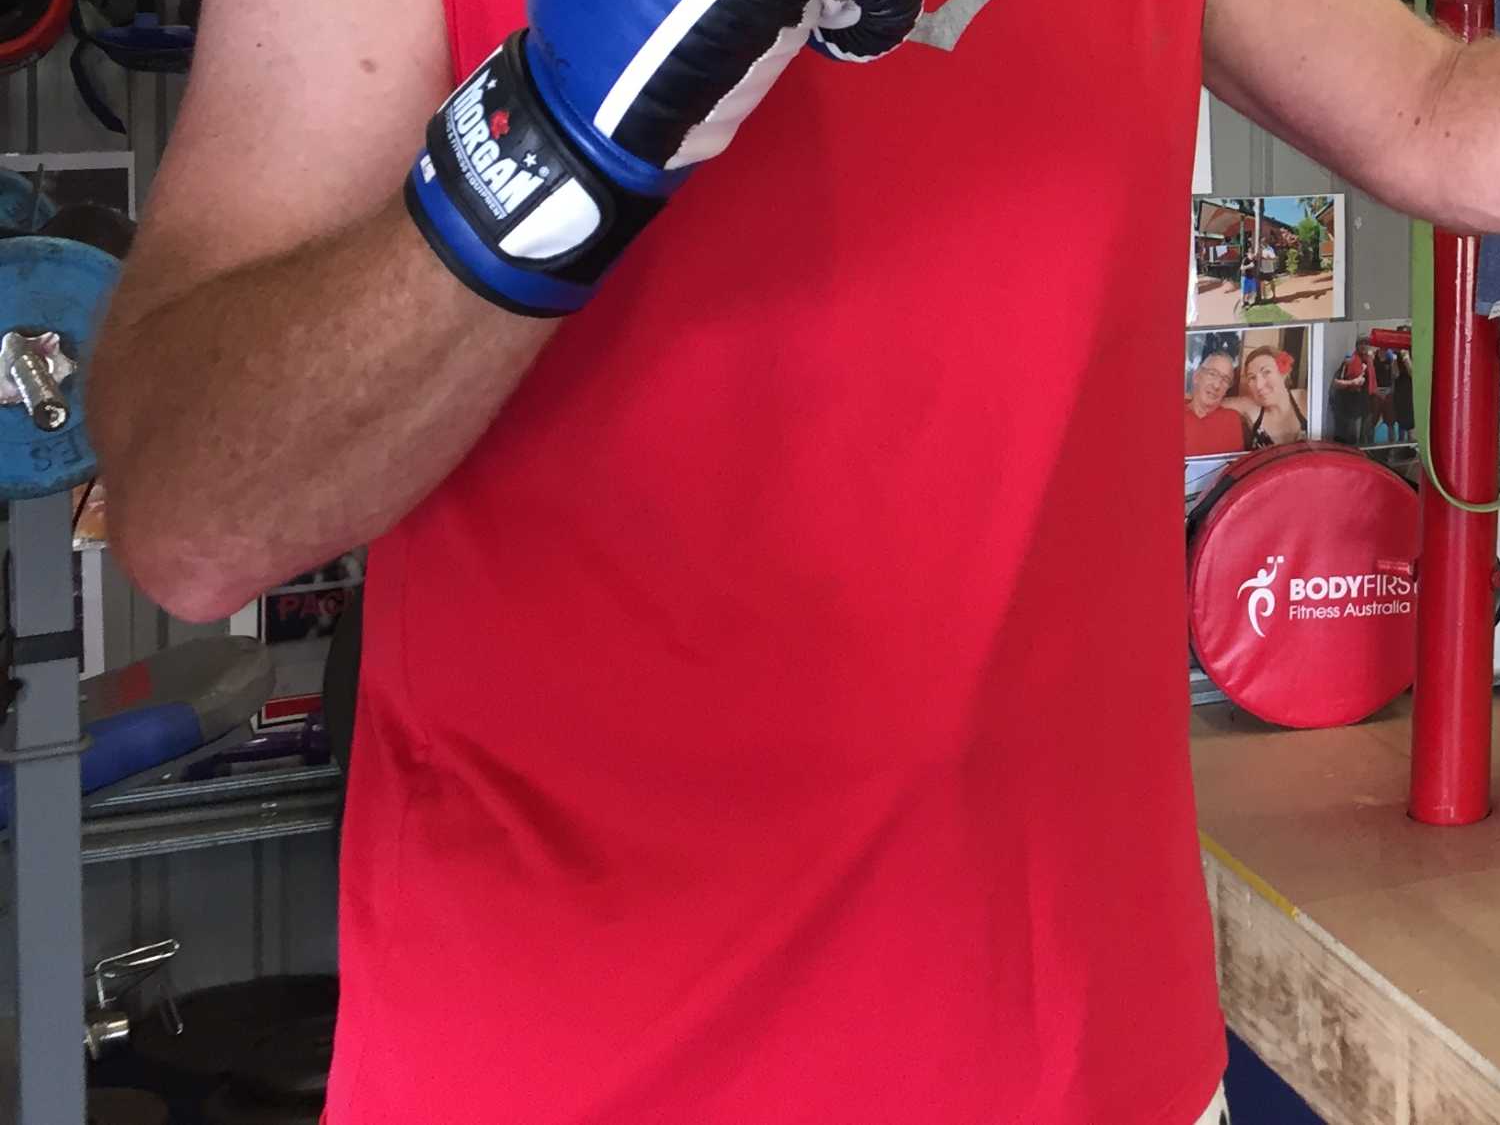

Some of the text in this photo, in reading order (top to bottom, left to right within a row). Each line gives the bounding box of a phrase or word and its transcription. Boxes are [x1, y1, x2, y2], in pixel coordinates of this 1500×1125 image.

[452, 68, 545, 214] MORGAN
[1289, 601, 1411, 621] Fitness Australia
